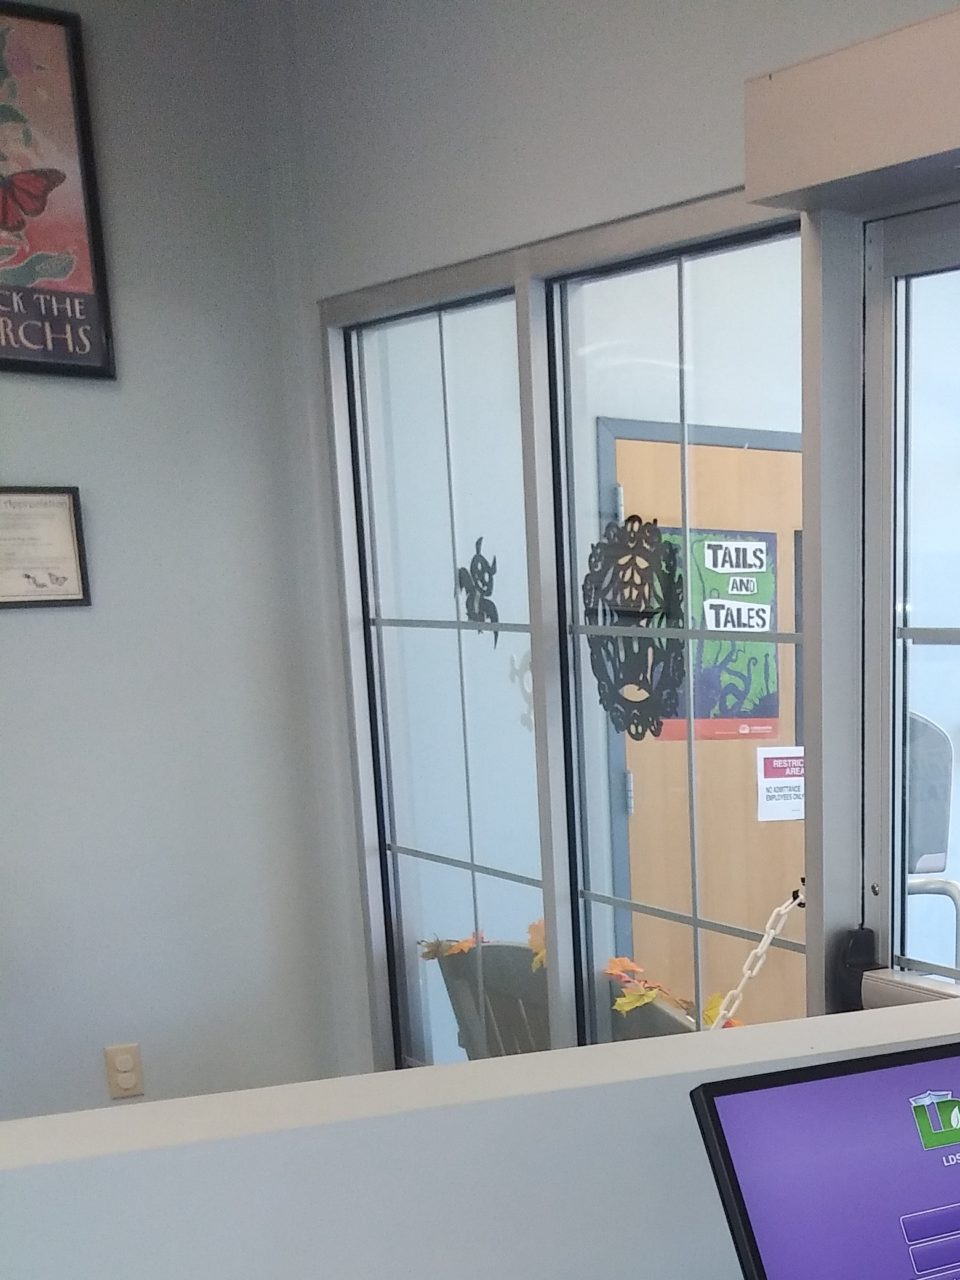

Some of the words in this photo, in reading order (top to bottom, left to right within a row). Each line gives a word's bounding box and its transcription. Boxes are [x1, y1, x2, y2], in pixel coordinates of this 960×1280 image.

[33, 294, 86, 320] THE
[0, 317, 91, 354] RCHS
[707, 543, 764, 570] TAILS
[730, 578, 755, 593] AND
[709, 603, 767, 628] TALES
